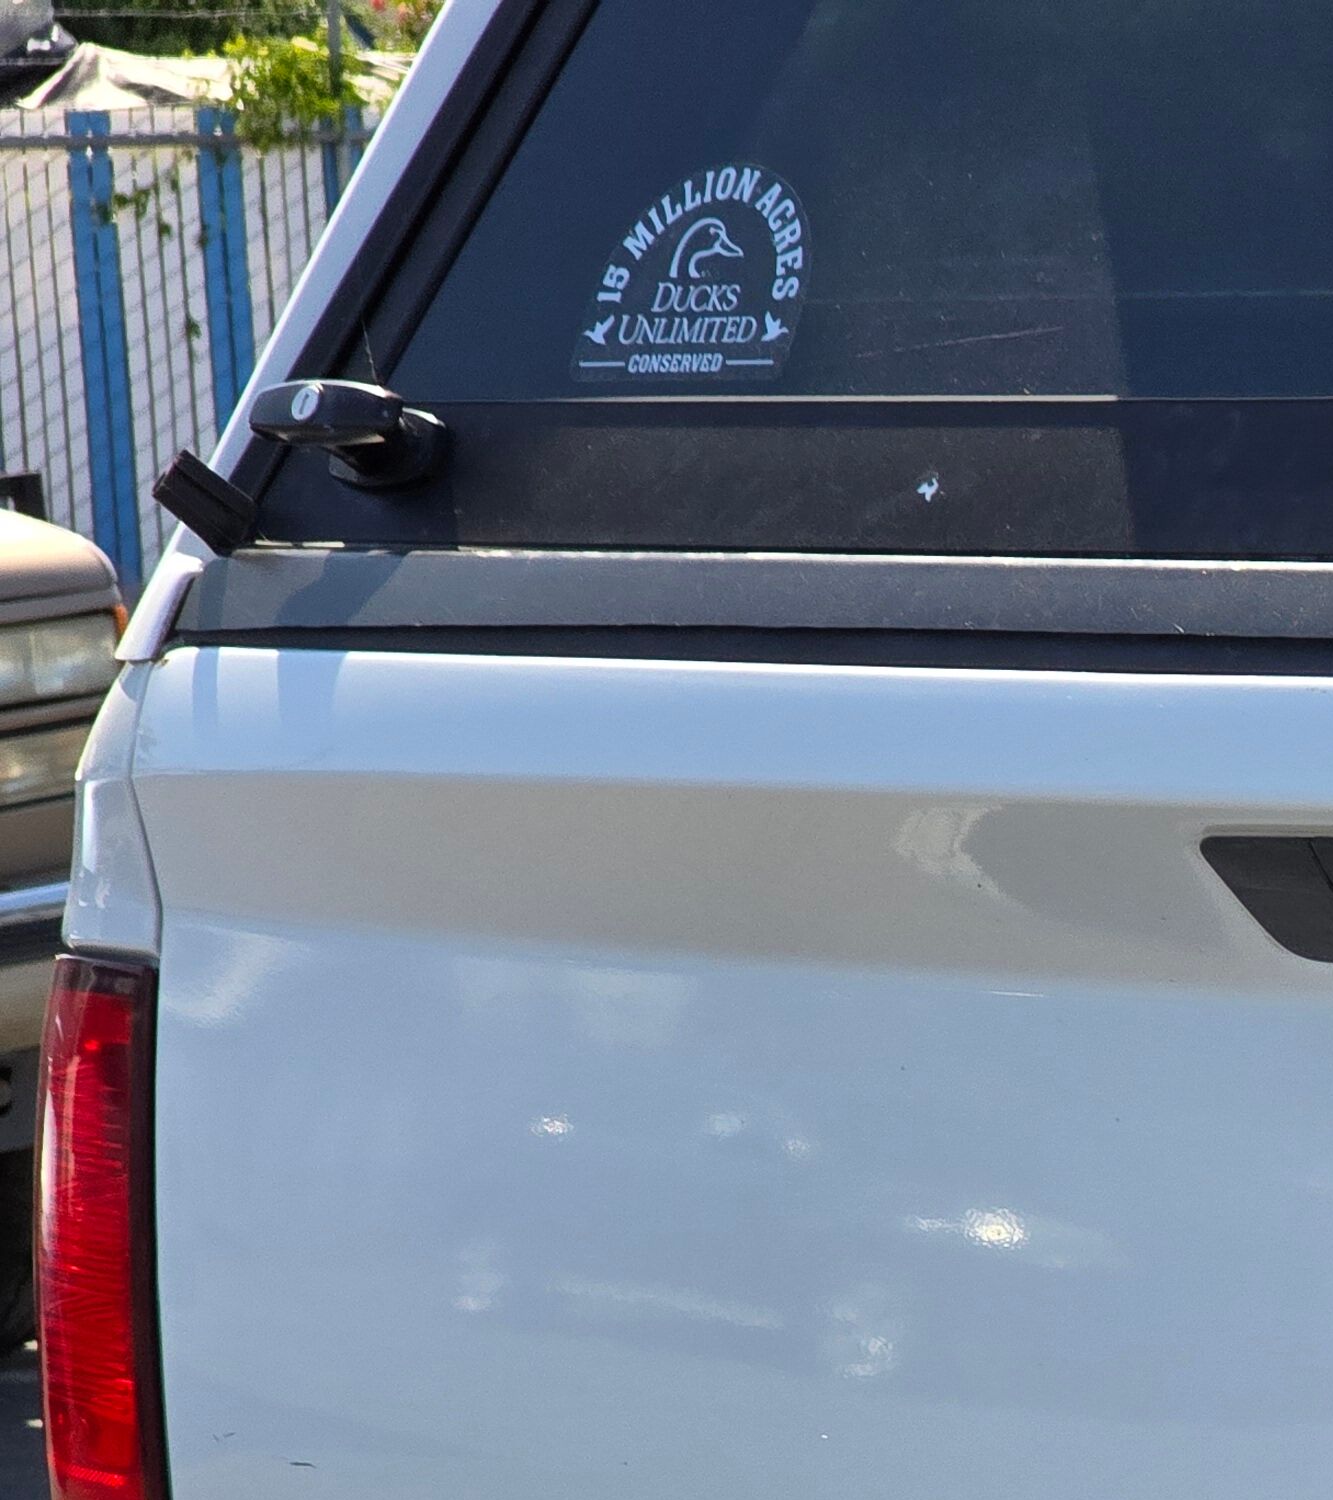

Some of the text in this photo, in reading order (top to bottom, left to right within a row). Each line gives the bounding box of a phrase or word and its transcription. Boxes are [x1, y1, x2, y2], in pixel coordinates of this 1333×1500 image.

[597, 167, 803, 304] 15 MILLION ACRES
[651, 282, 741, 312] DUCKS
[618, 314, 758, 345] UNLIMITED
[628, 353, 724, 373] CONSERVED
